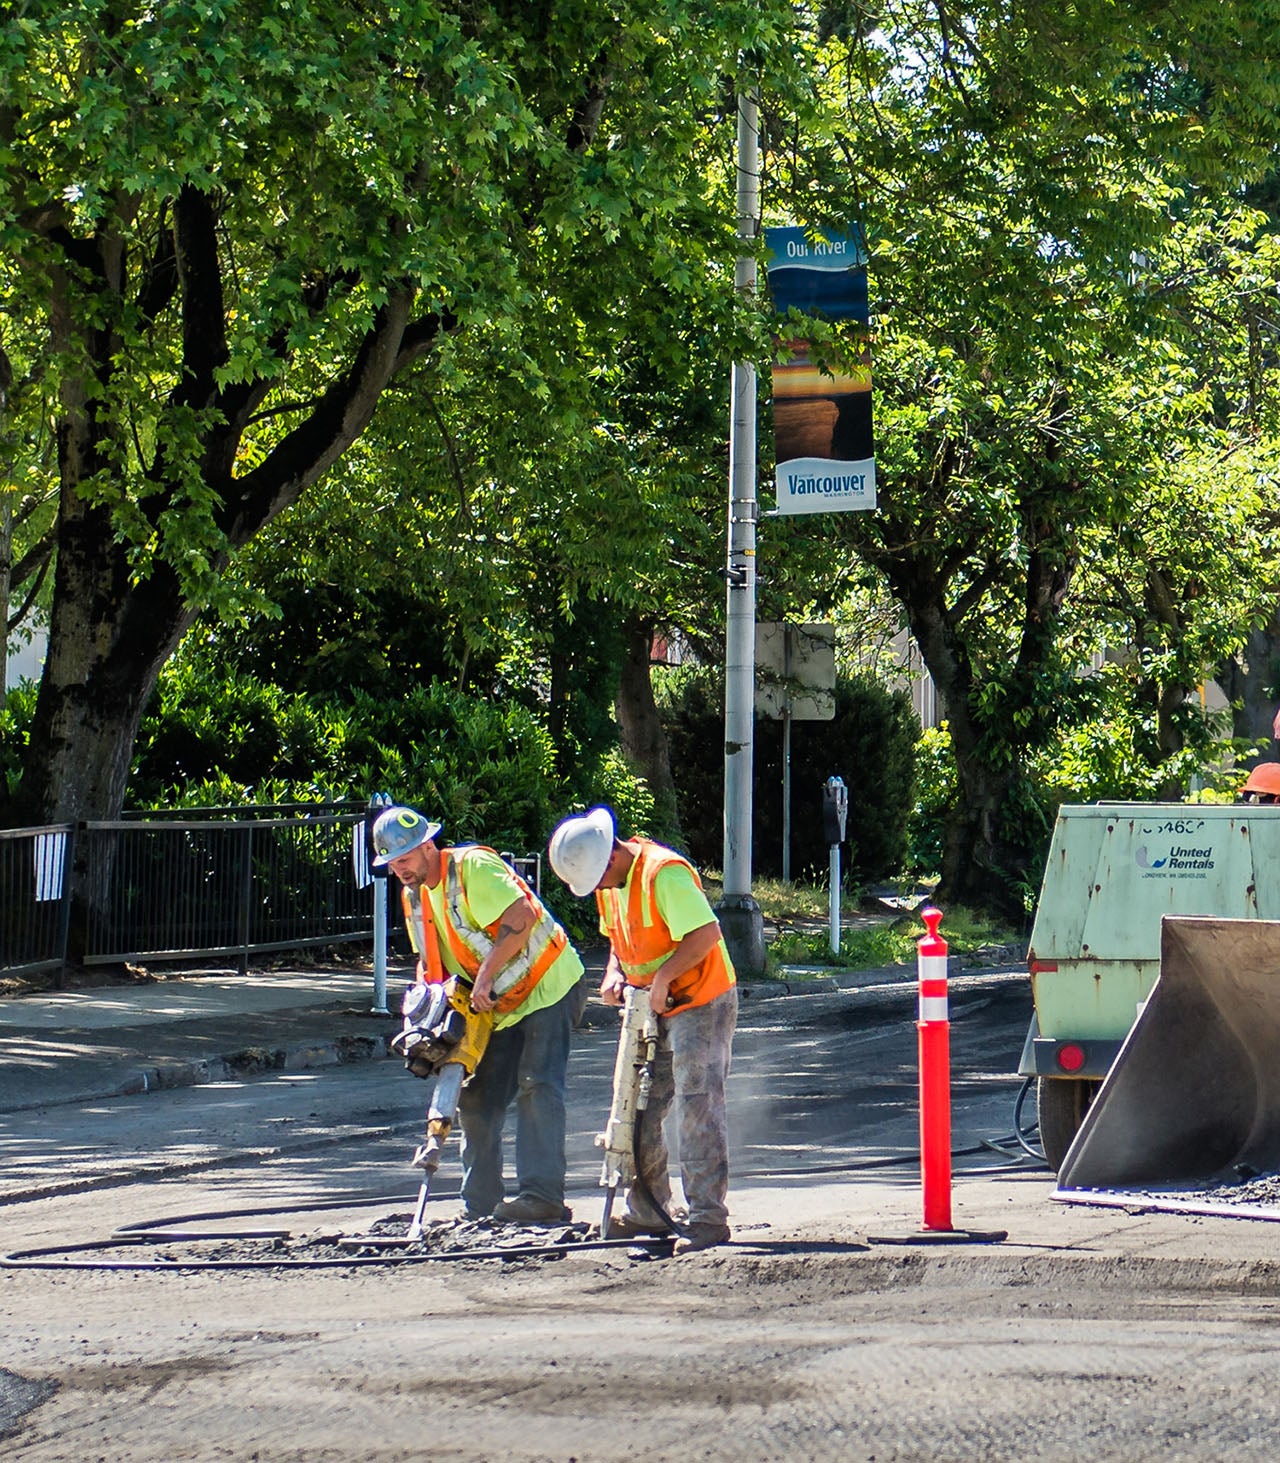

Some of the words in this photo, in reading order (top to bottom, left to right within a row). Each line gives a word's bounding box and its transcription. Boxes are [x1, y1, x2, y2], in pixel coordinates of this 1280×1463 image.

[786, 240, 809, 258] Our
[814, 240, 848, 257] River
[787, 473, 866, 496] Vancouver
[1169, 846, 1213, 859] United
[1168, 858, 1215, 870] Rentals
